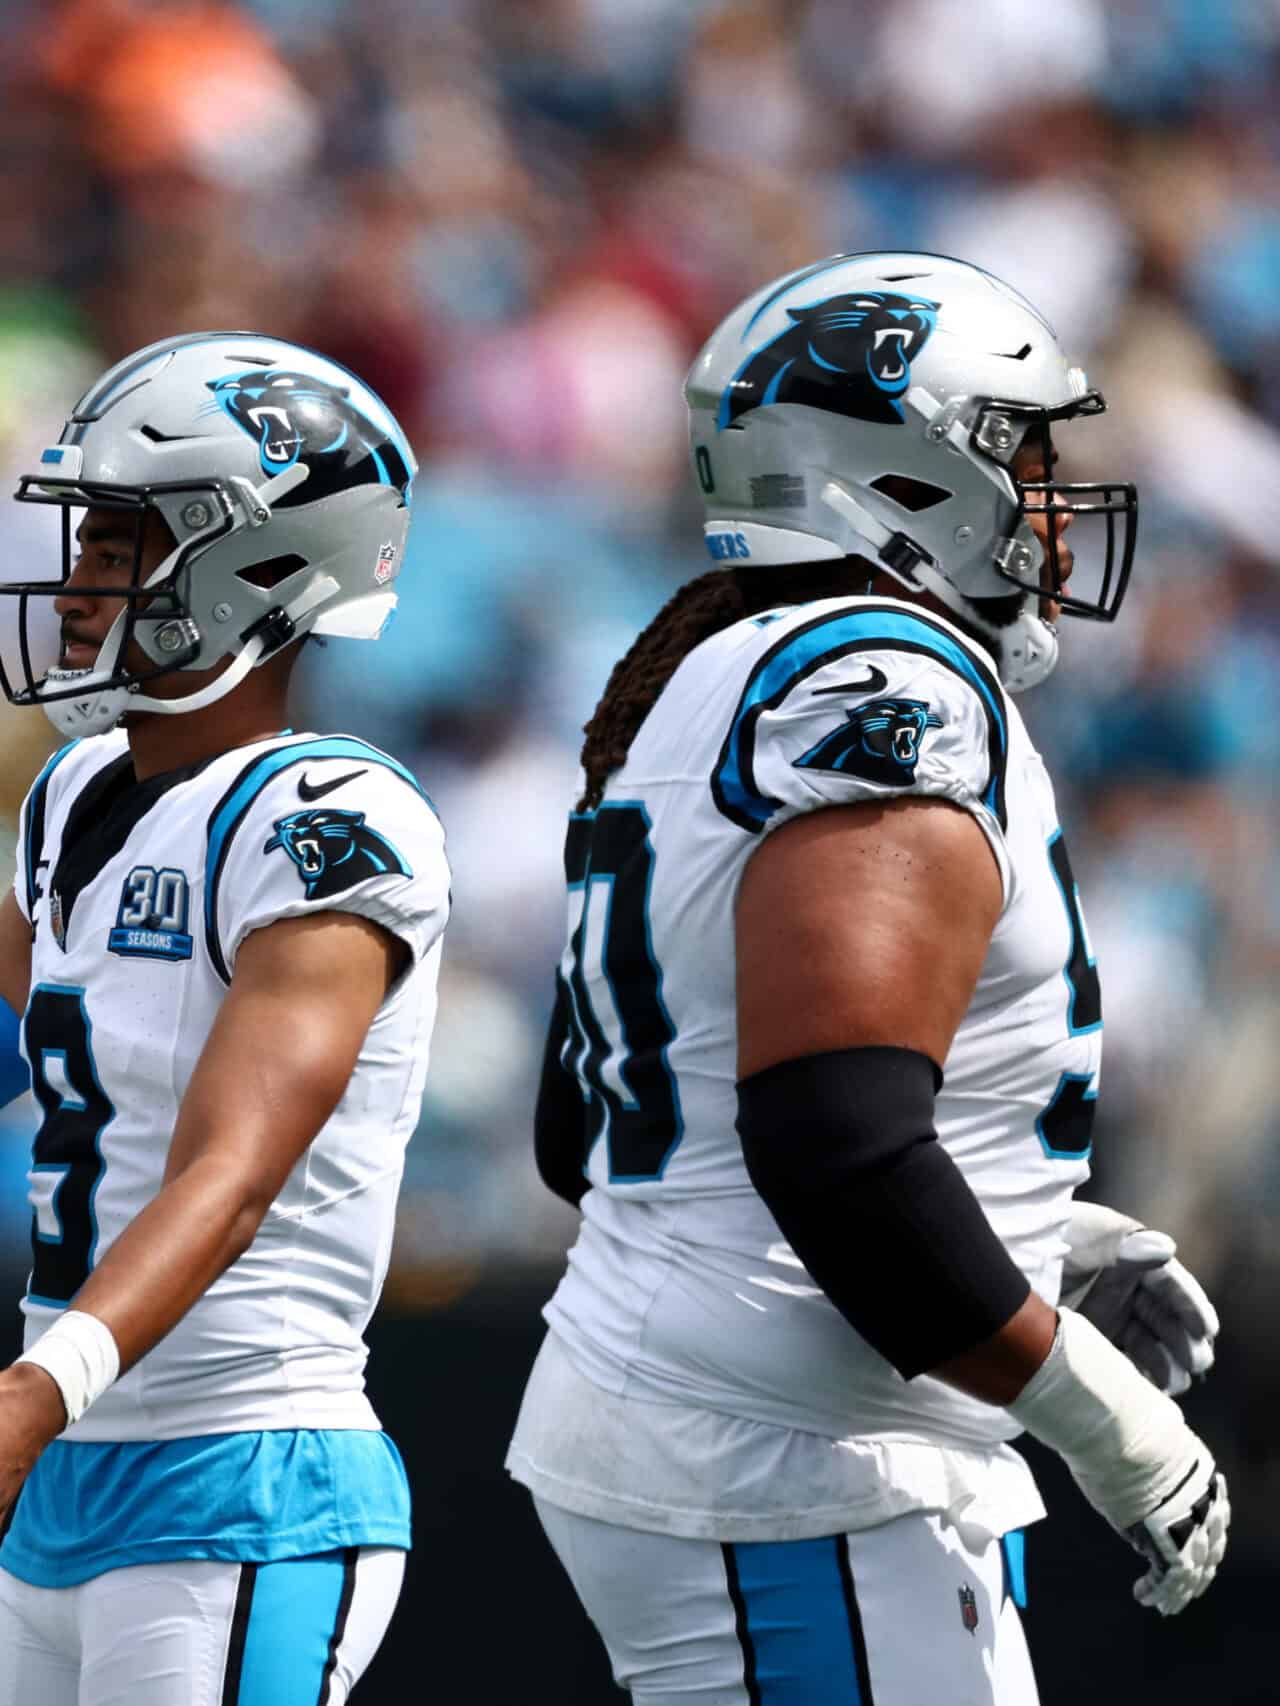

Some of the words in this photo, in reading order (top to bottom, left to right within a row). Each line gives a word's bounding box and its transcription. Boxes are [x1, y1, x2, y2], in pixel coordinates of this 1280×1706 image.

[123, 868, 184, 932] 30
[127, 931, 173, 950] SEASONS
[24, 983, 117, 1310] 9
